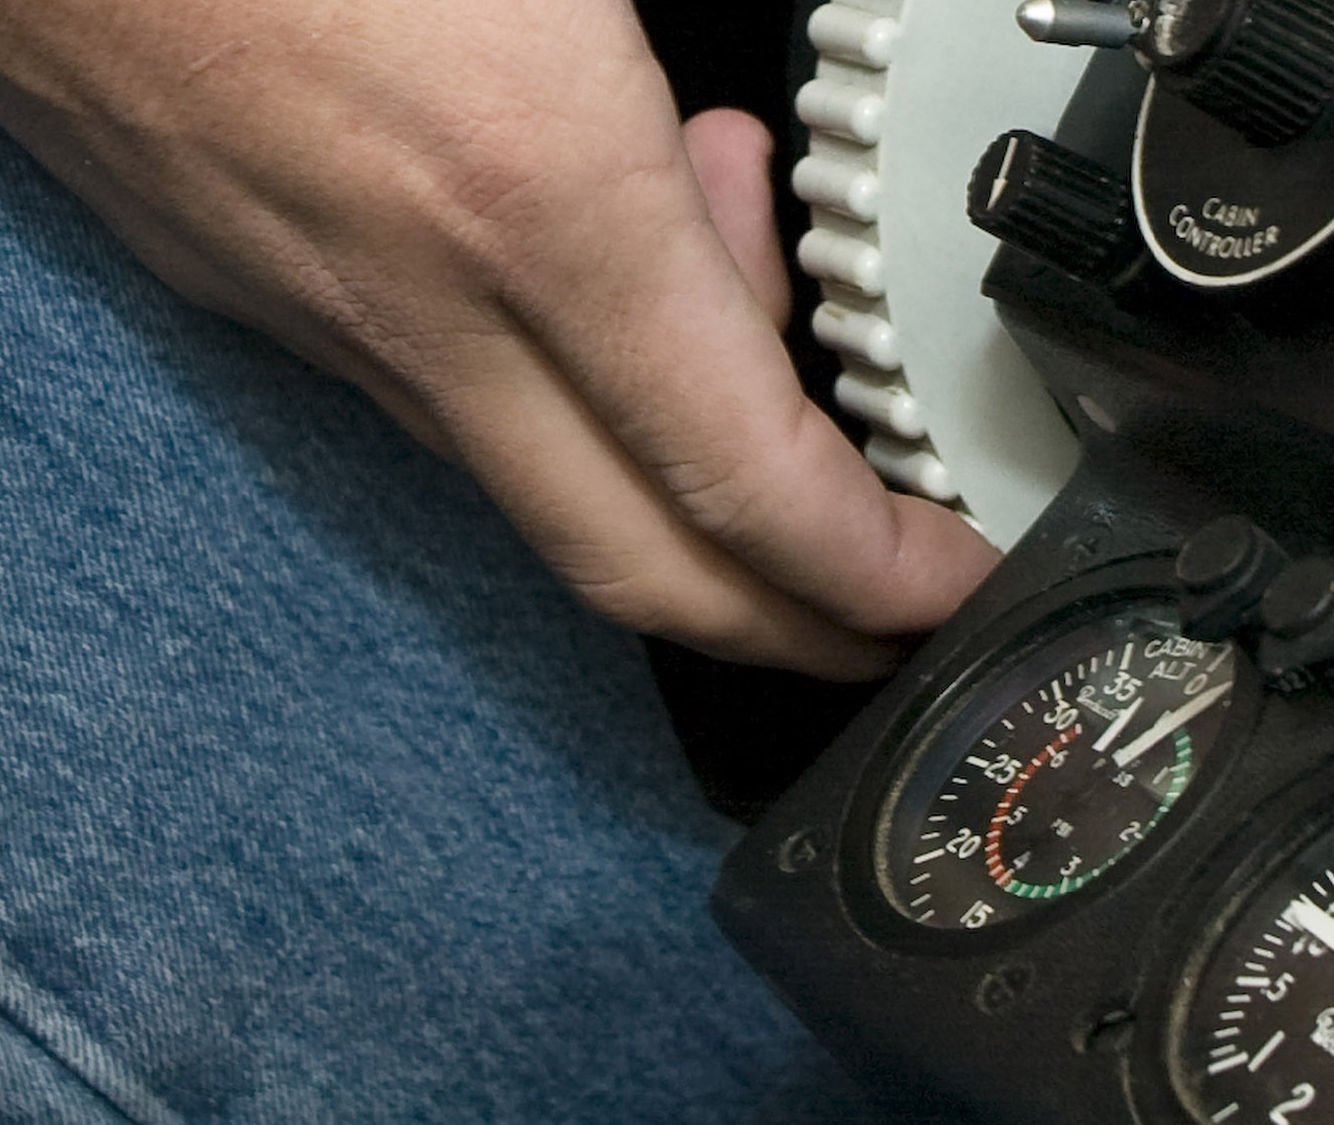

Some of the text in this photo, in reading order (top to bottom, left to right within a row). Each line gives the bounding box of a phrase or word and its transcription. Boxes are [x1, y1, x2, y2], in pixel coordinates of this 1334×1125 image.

[1202, 197, 1259, 227] CABIN
[1169, 204, 1280, 259] CONTROLLER
[1144, 636, 1210, 660] CABIN
[1148, 661, 1197, 680] ALT
[1103, 671, 1143, 701] 35
[1044, 699, 1079, 731] 30
[985, 753, 1023, 785] 25
[946, 827, 982, 859] 20
[960, 900, 995, 929] 15
